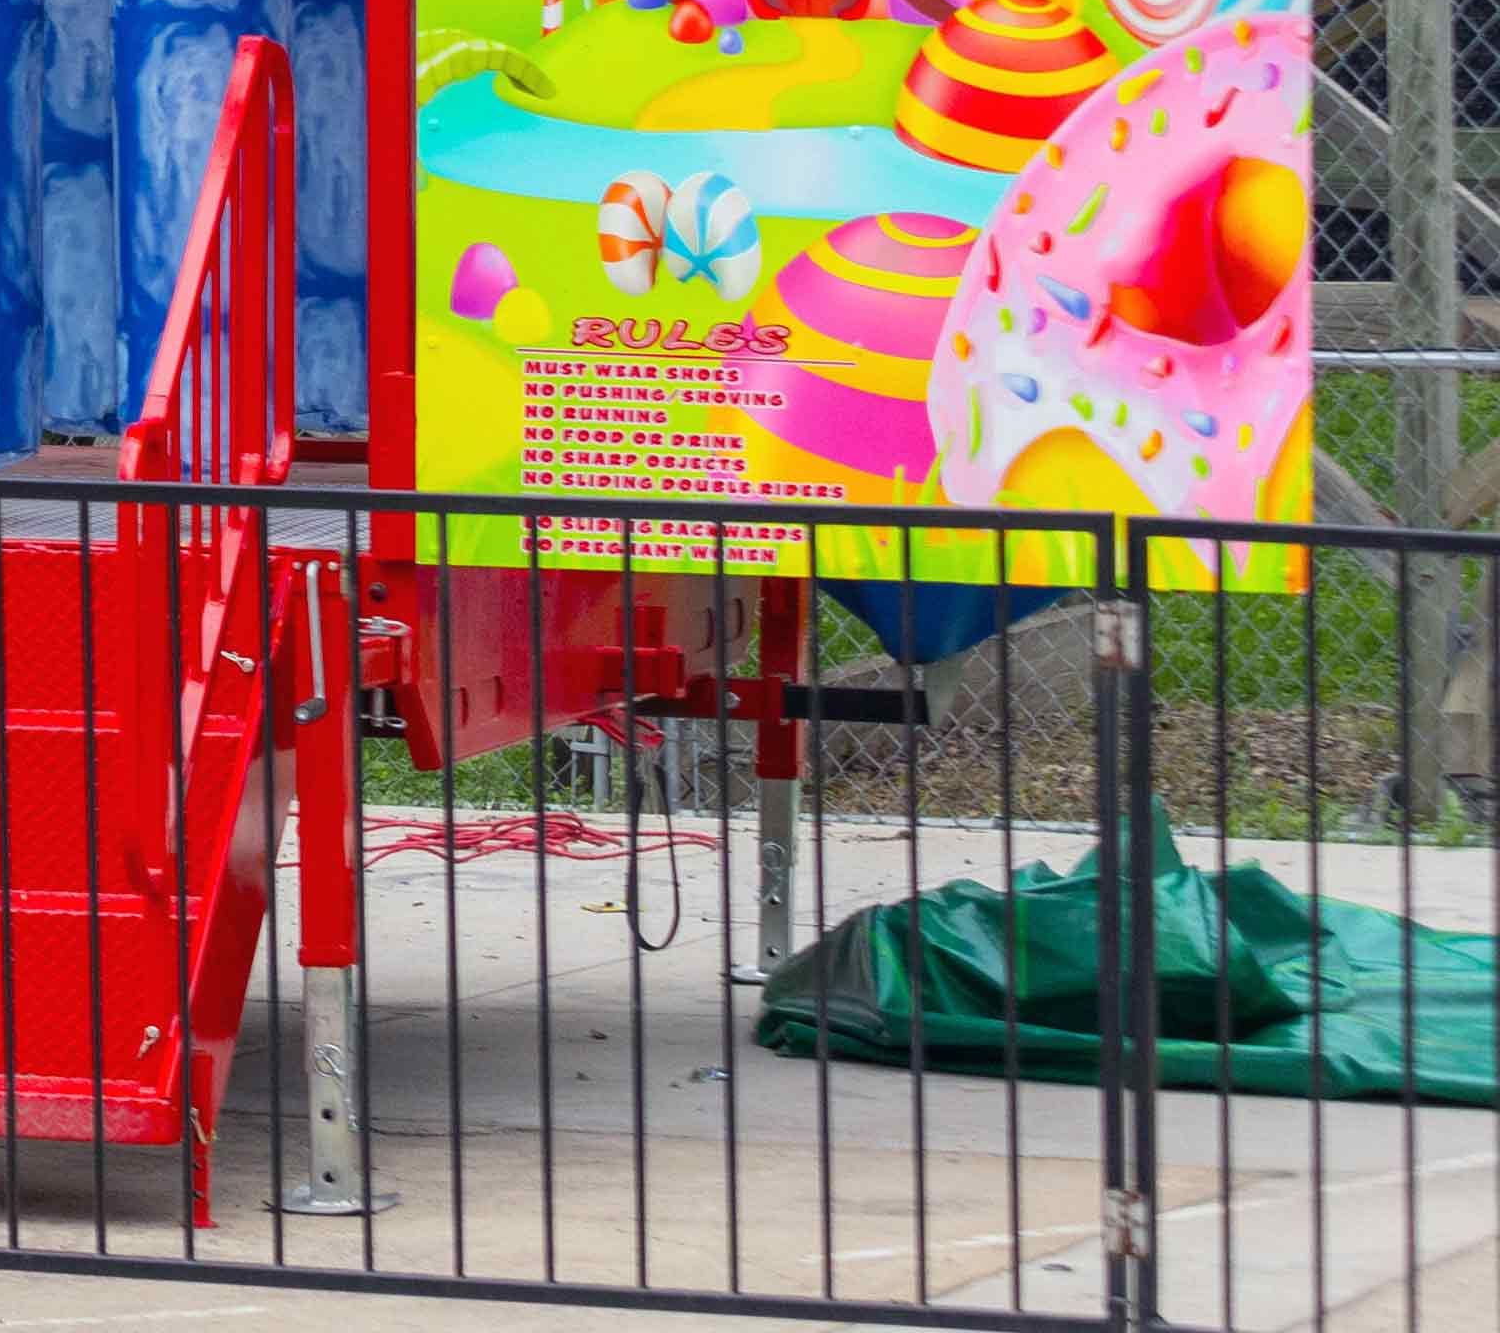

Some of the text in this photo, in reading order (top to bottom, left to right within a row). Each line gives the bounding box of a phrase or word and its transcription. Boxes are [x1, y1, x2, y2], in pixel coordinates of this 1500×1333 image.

[571, 317, 792, 355] RULES
[524, 361, 740, 382] MUST WEAR SHOES
[524, 383, 783, 406] NO PUSHING/SHOVING
[524, 405, 667, 423] NO RUNNING
[524, 428, 743, 449] NO FOOD OR DRINK
[523, 449, 746, 471] NO SHARP OBJECTS
[523, 471, 844, 498] NO SLIDING DOUBLE RIDERS
